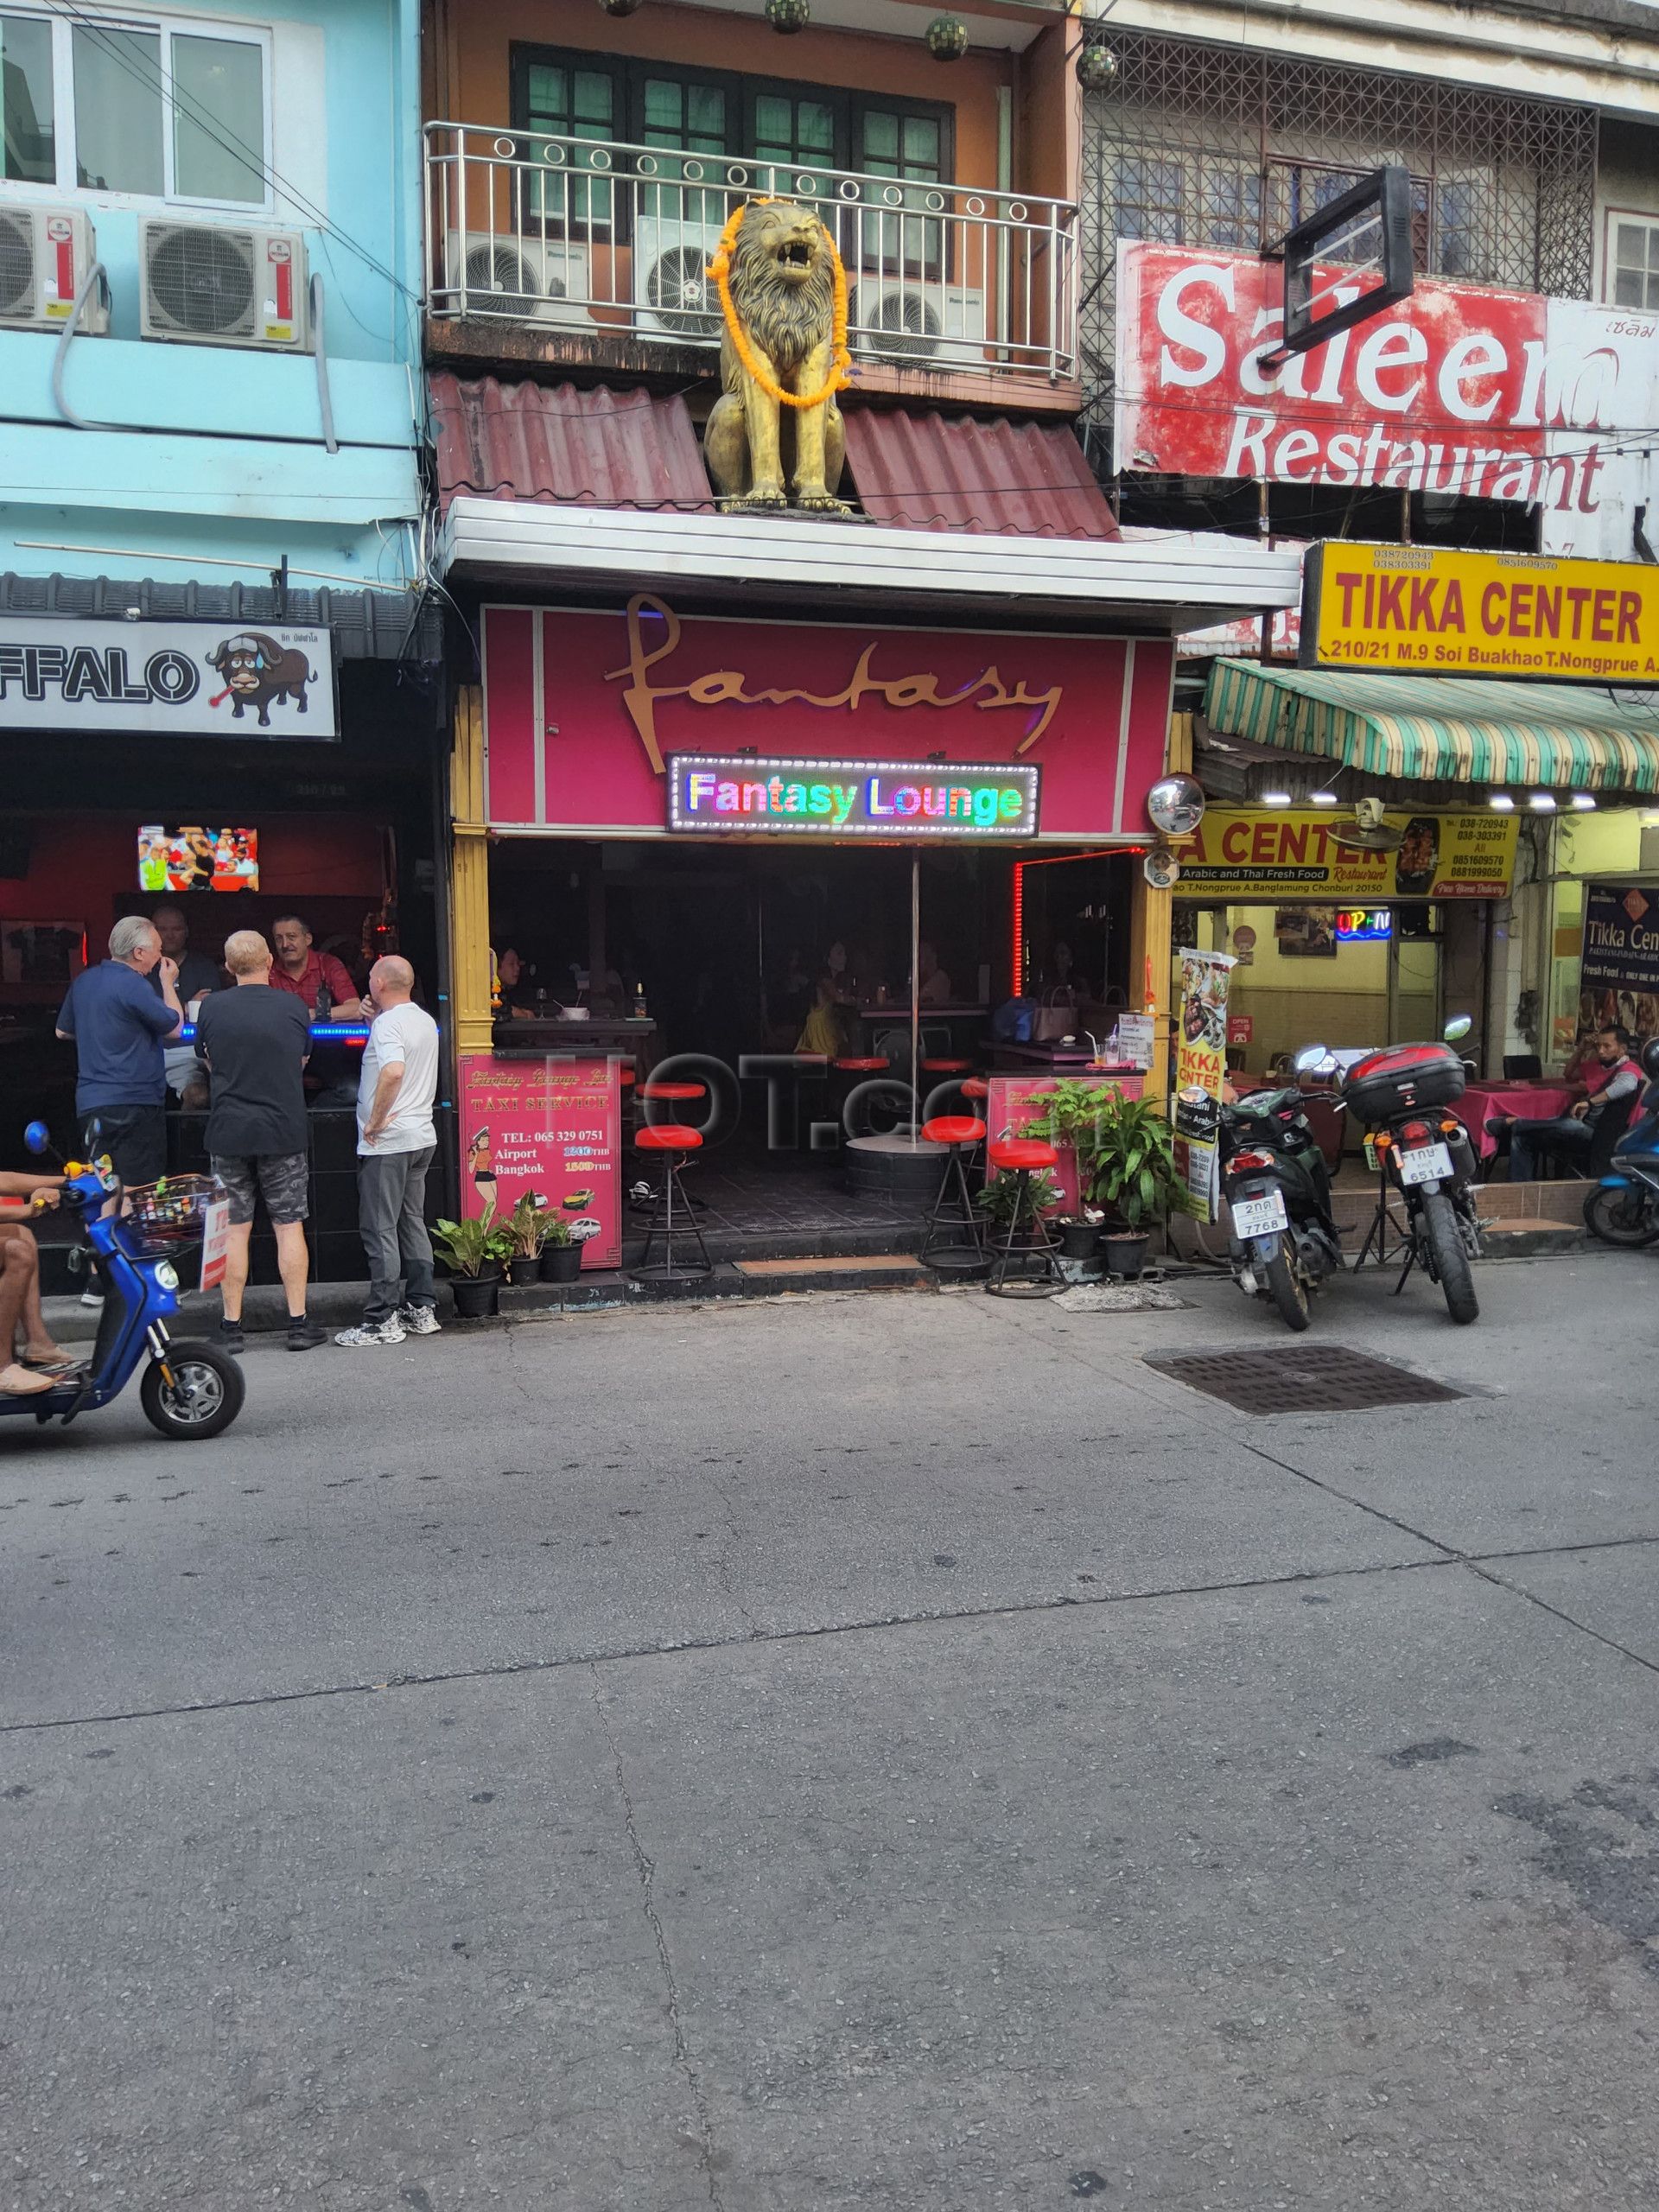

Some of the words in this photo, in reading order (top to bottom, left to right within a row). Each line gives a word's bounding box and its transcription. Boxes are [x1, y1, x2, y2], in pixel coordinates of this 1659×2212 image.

[1224, 406, 1605, 513] Restaurant
[1373, 560, 1431, 569] 038303391
[1336, 572, 1465, 633] TIKKA
[1481, 581, 1643, 644] CENTER
[1332, 639, 1389, 658] 210/21
[1397, 643, 1428, 660] M.9
[1434, 645, 1462, 662] Soi
[1468, 646, 1543, 666] Buakhao
[1545, 651, 1638, 674] T.Nongprue
[687, 772, 858, 825] Fantasy
[868, 777, 1023, 826] Lounge
[1182, 868, 1218, 879] Arabic
[1219, 868, 1242, 879] and
[1243, 868, 1264, 879] Thai
[1266, 869, 1295, 879] Fresh
[1297, 869, 1325, 879] Food
[1333, 866, 1388, 882] Restaurant
[1188, 883, 1242, 893] T.Nongprue
[1243, 883, 1310, 893] A.Banglamung
[1588, 920, 1625, 948] Tikka
[1583, 963, 1602, 976] Fresh
[1603, 966, 1619, 978] Food
[1179, 1067, 1219, 1089] CNTER
[471, 1097, 519, 1113] TAXI
[525, 1095, 610, 1111] SERVICE
[502, 1133, 531, 1143] TEL:
[534, 1132, 554, 1141] 065
[556, 1131, 576, 1141] 329
[578, 1130, 603, 1141] 0751
[495, 1148, 537, 1161] Airport
[495, 1163, 544, 1176] Bangkok
[1410, 1166, 1444, 1181] 6514
[1244, 1220, 1278, 1235] 7768
